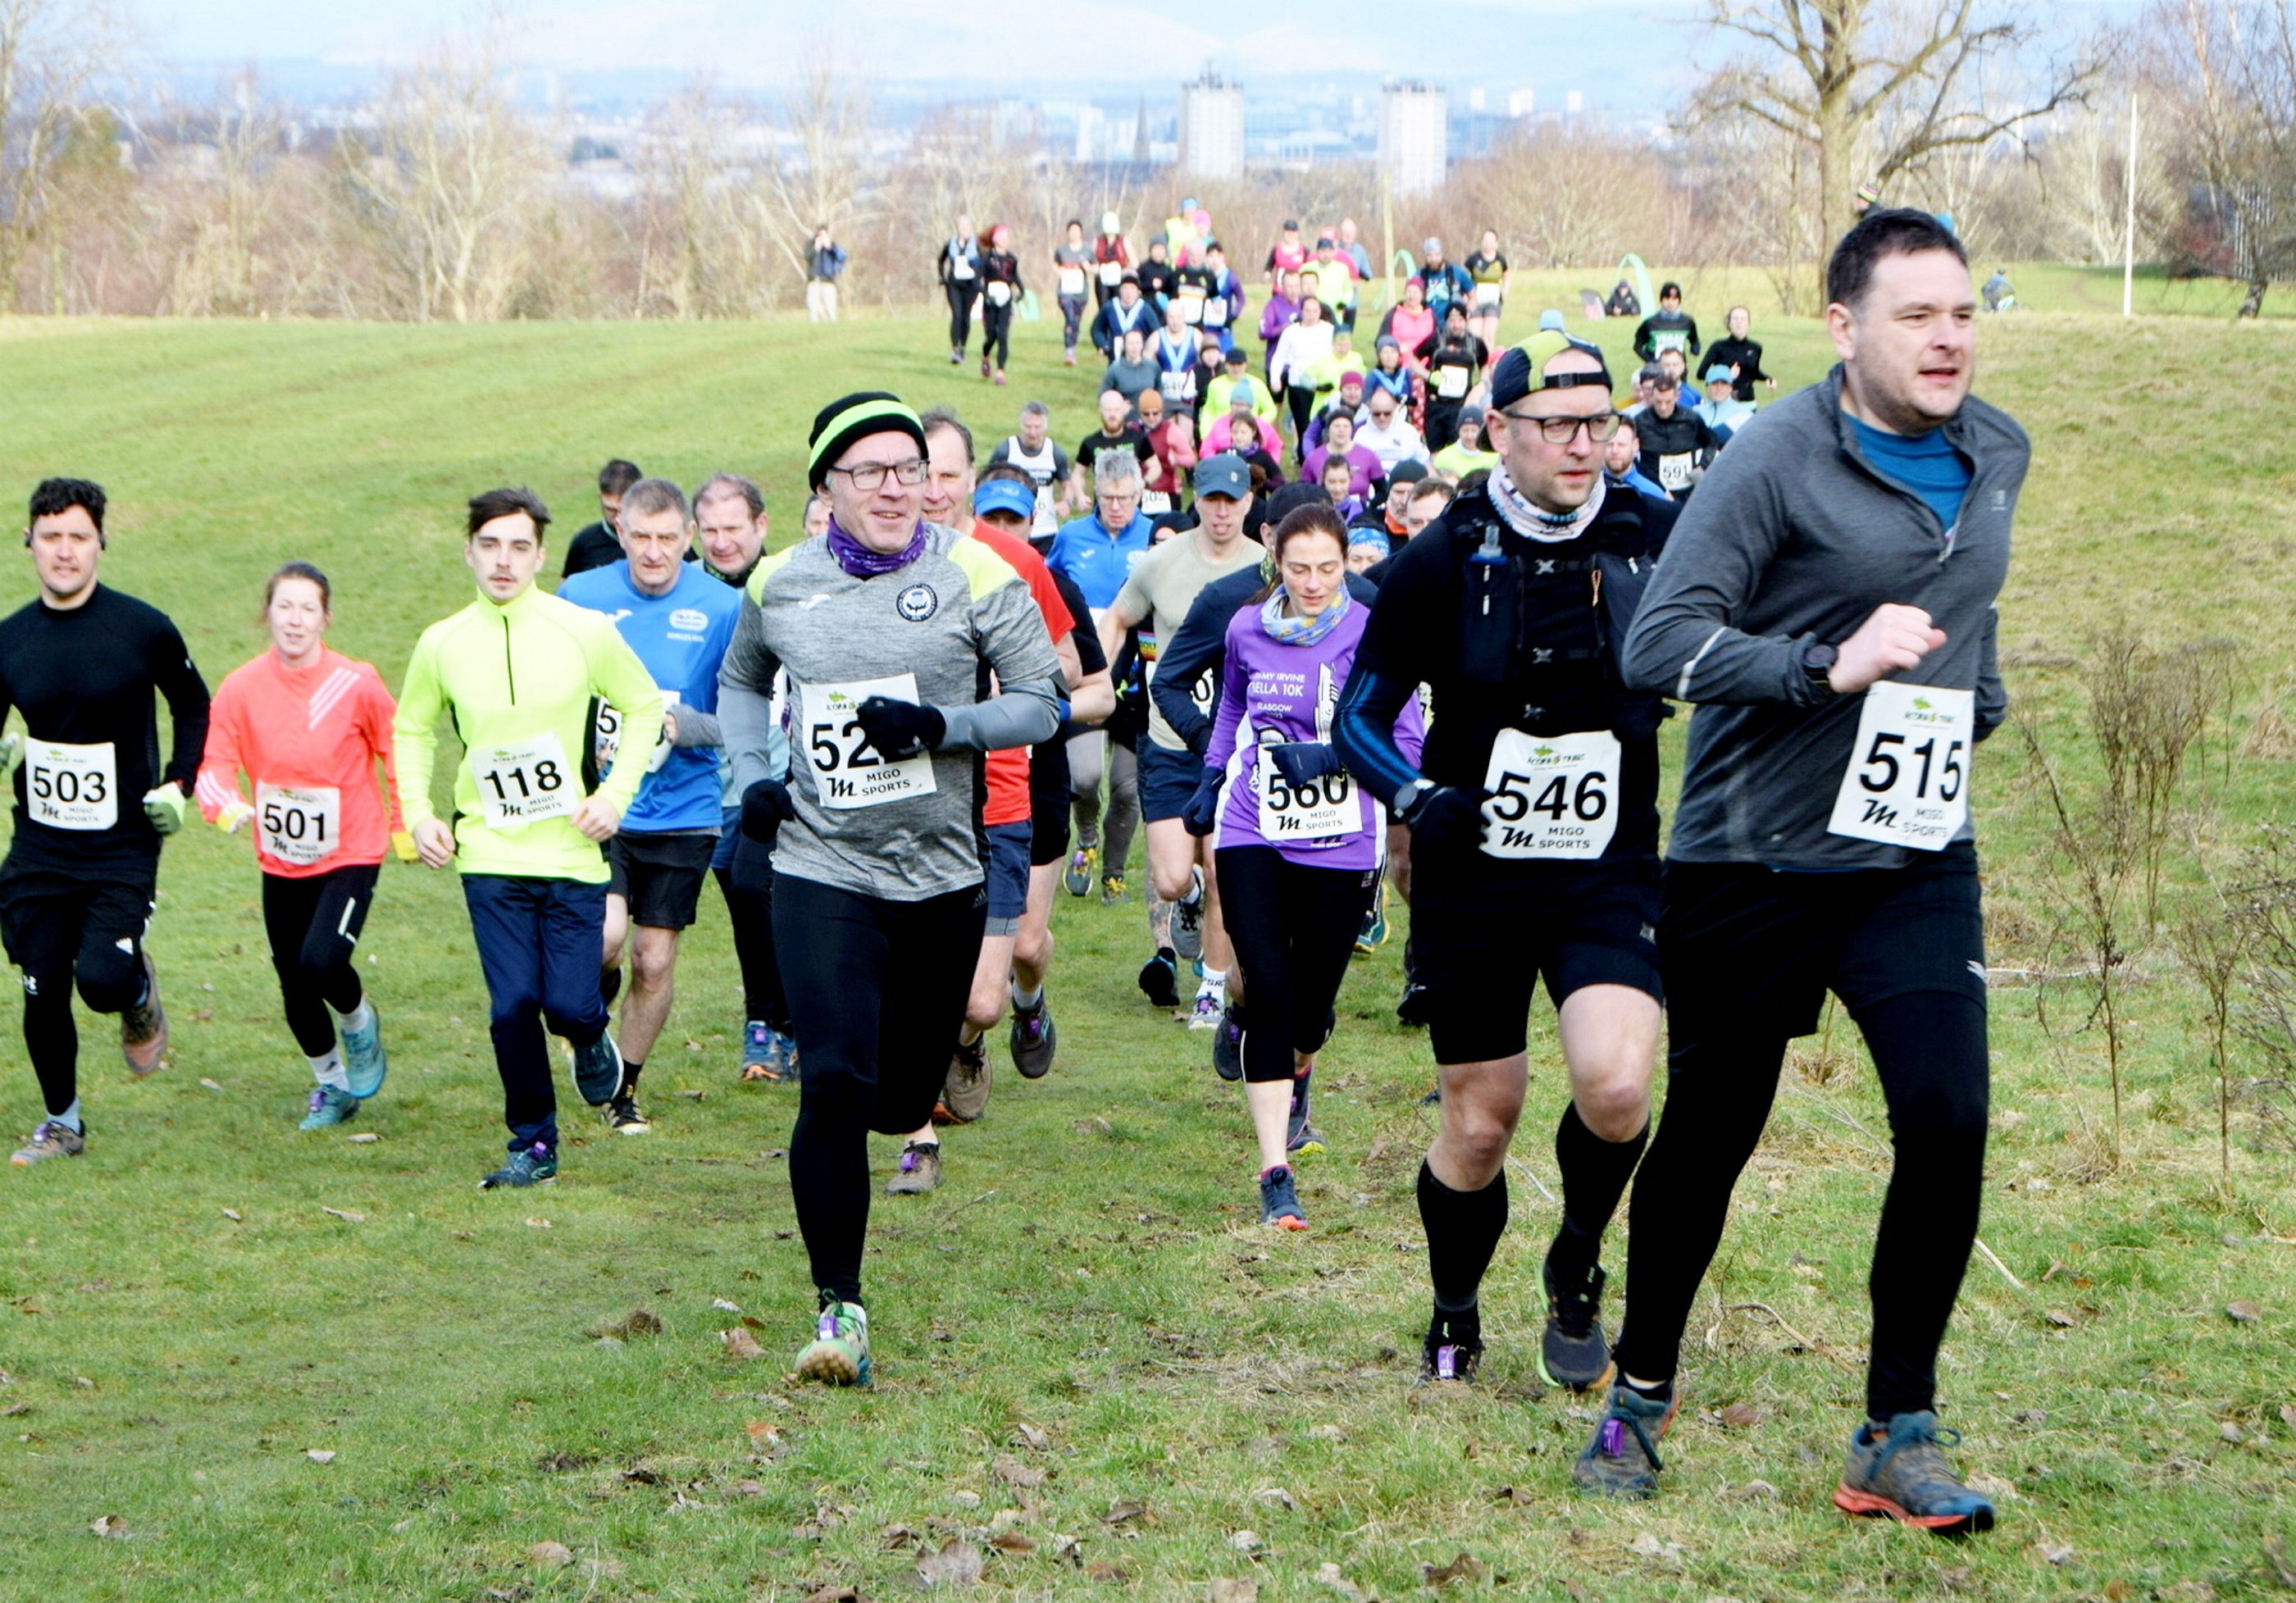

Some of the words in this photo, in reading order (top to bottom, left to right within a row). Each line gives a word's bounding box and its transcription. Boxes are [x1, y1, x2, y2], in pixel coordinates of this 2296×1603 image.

[1277, 673, 1305, 683] IRVINE
[1282, 684, 1304, 697] 10K
[812, 721, 918, 772] 52
[1859, 731, 1963, 802] 515
[484, 759, 563, 799] 118
[867, 768, 900, 782] MIGO
[33, 765, 106, 803] 503
[862, 779, 911, 797] SPORTS
[1268, 773, 1348, 811] 560
[1492, 771, 1606, 821] 546
[530, 795, 554, 806] MIGO
[526, 802, 563, 814] SPORTS
[1310, 810, 1336, 819] MIGO
[1915, 808, 1943, 820] MIGO
[264, 802, 325, 842] 501
[1305, 819, 1343, 830] SPORTS
[1902, 821, 1947, 837] SPORTS
[1548, 827, 1584, 836] MIGO
[1538, 840, 1591, 849] SPORTS
